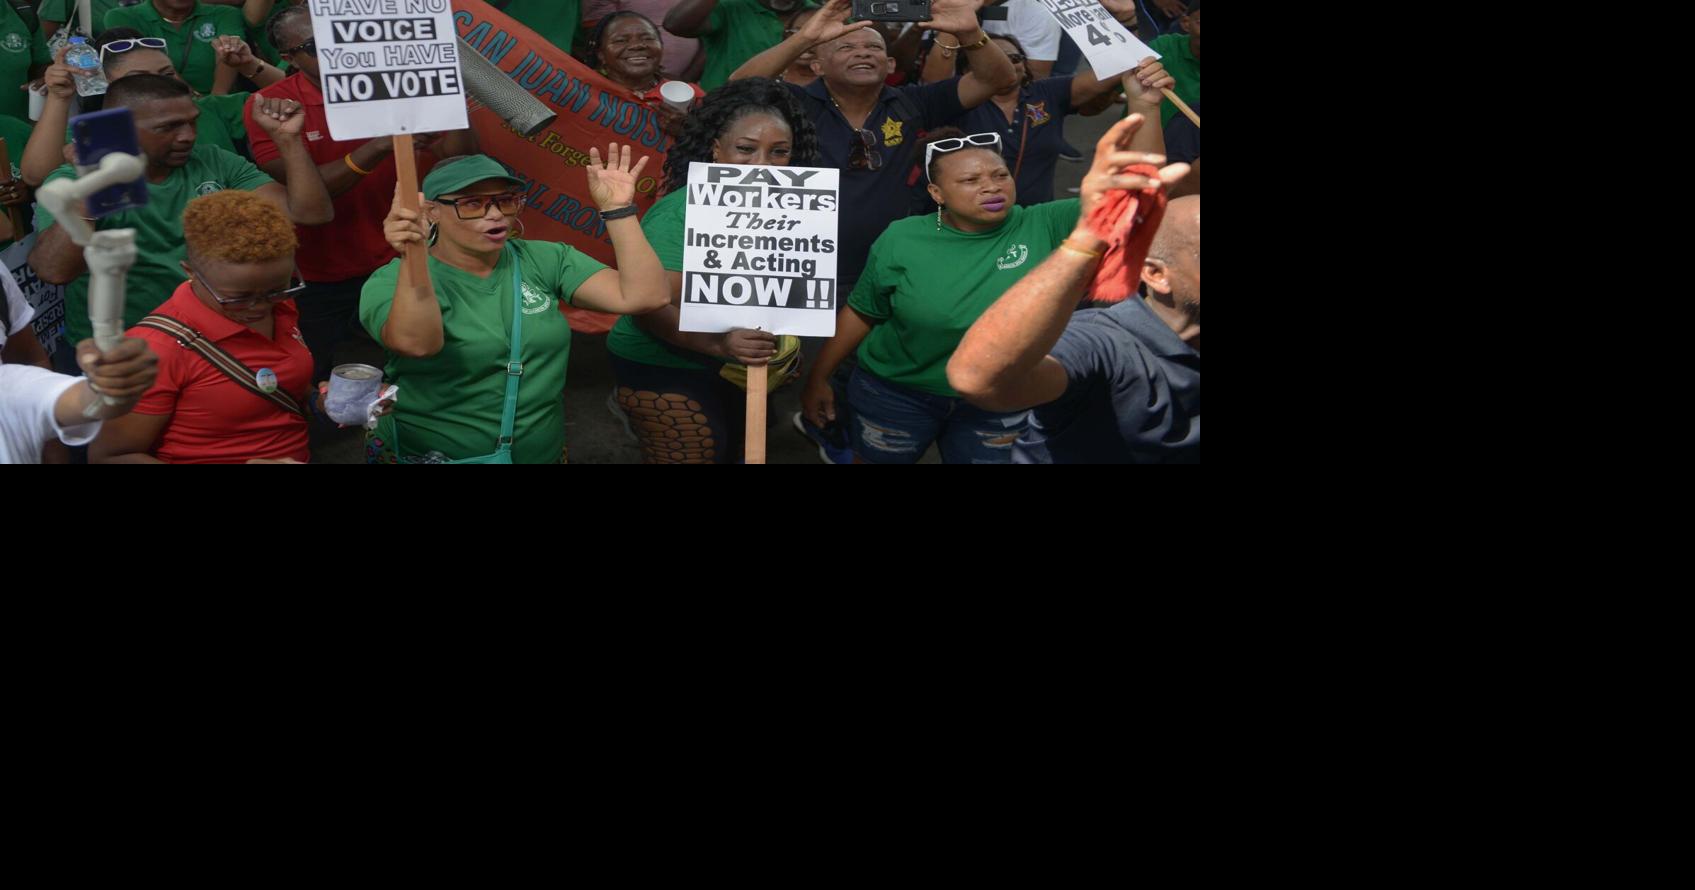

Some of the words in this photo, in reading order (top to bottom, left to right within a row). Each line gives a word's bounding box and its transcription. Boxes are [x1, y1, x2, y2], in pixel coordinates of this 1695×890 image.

[313, 0, 397, 16] HAVE
[405, 0, 446, 14] NO
[1053, 9, 1095, 29] More
[333, 19, 433, 42] VOICE
[320, 48, 376, 69] You
[383, 43, 457, 66] HAVE
[326, 74, 374, 102] NO
[380, 68, 459, 98] VOTE
[504, 51, 592, 113] JUAN
[588, 90, 668, 153] NOIS
[707, 166, 820, 187] PAY
[690, 184, 836, 212] Workers
[726, 211, 801, 231] Their
[687, 227, 835, 254] Increments
[703, 250, 722, 269] &
[731, 251, 817, 278] Acting
[690, 274, 793, 306] NOW
[806, 280, 830, 308] !!
